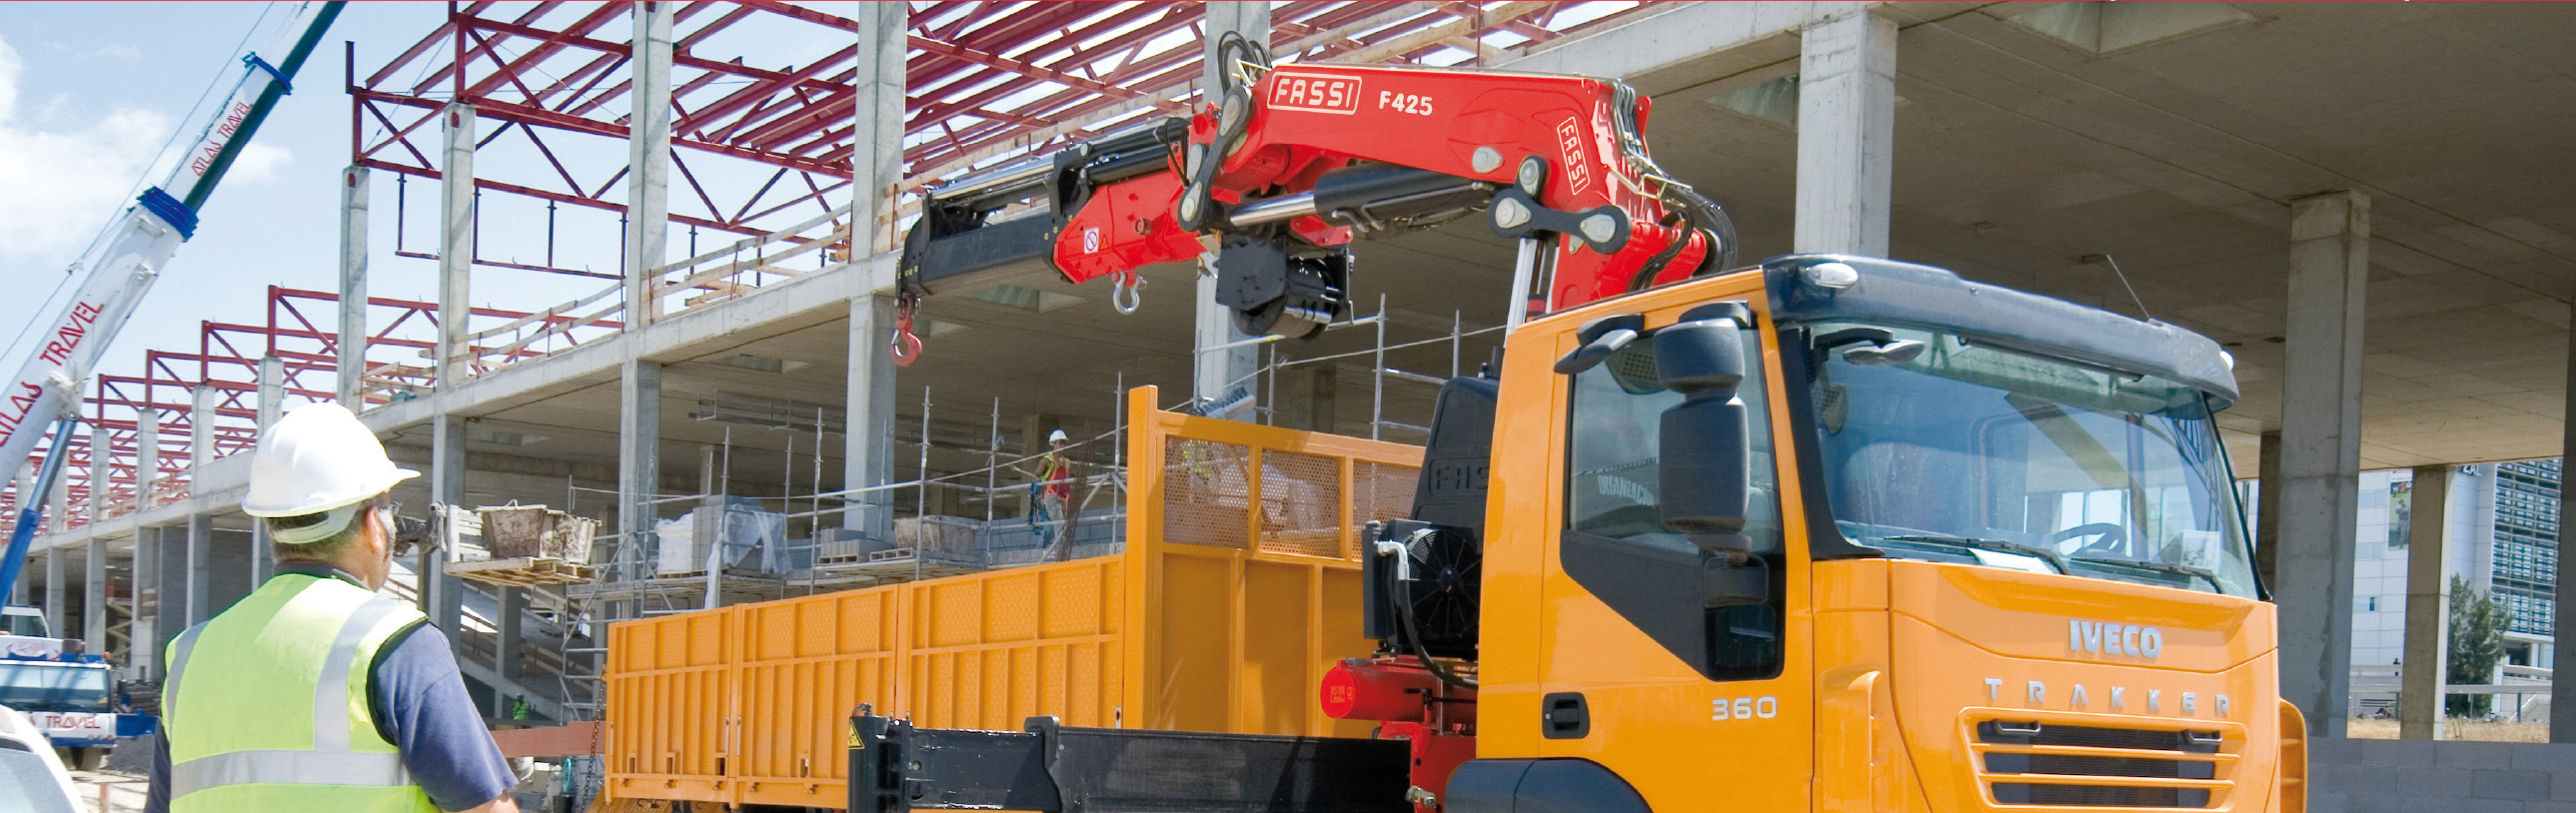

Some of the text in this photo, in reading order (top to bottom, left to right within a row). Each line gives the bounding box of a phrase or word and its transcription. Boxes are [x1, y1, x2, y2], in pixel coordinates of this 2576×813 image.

[1274, 77, 1354, 110] FASSI
[1378, 90, 1433, 116] F425
[192, 102, 253, 177] ATLAS TRAVEL
[1561, 124, 1586, 188] FASSI
[39, 301, 105, 367] TRAVEL
[2069, 618, 2162, 659] IVECO
[1712, 695, 1778, 721] 360
[1984, 677, 2230, 717] TRAKKER
[45, 715, 101, 729] TRAVEL
